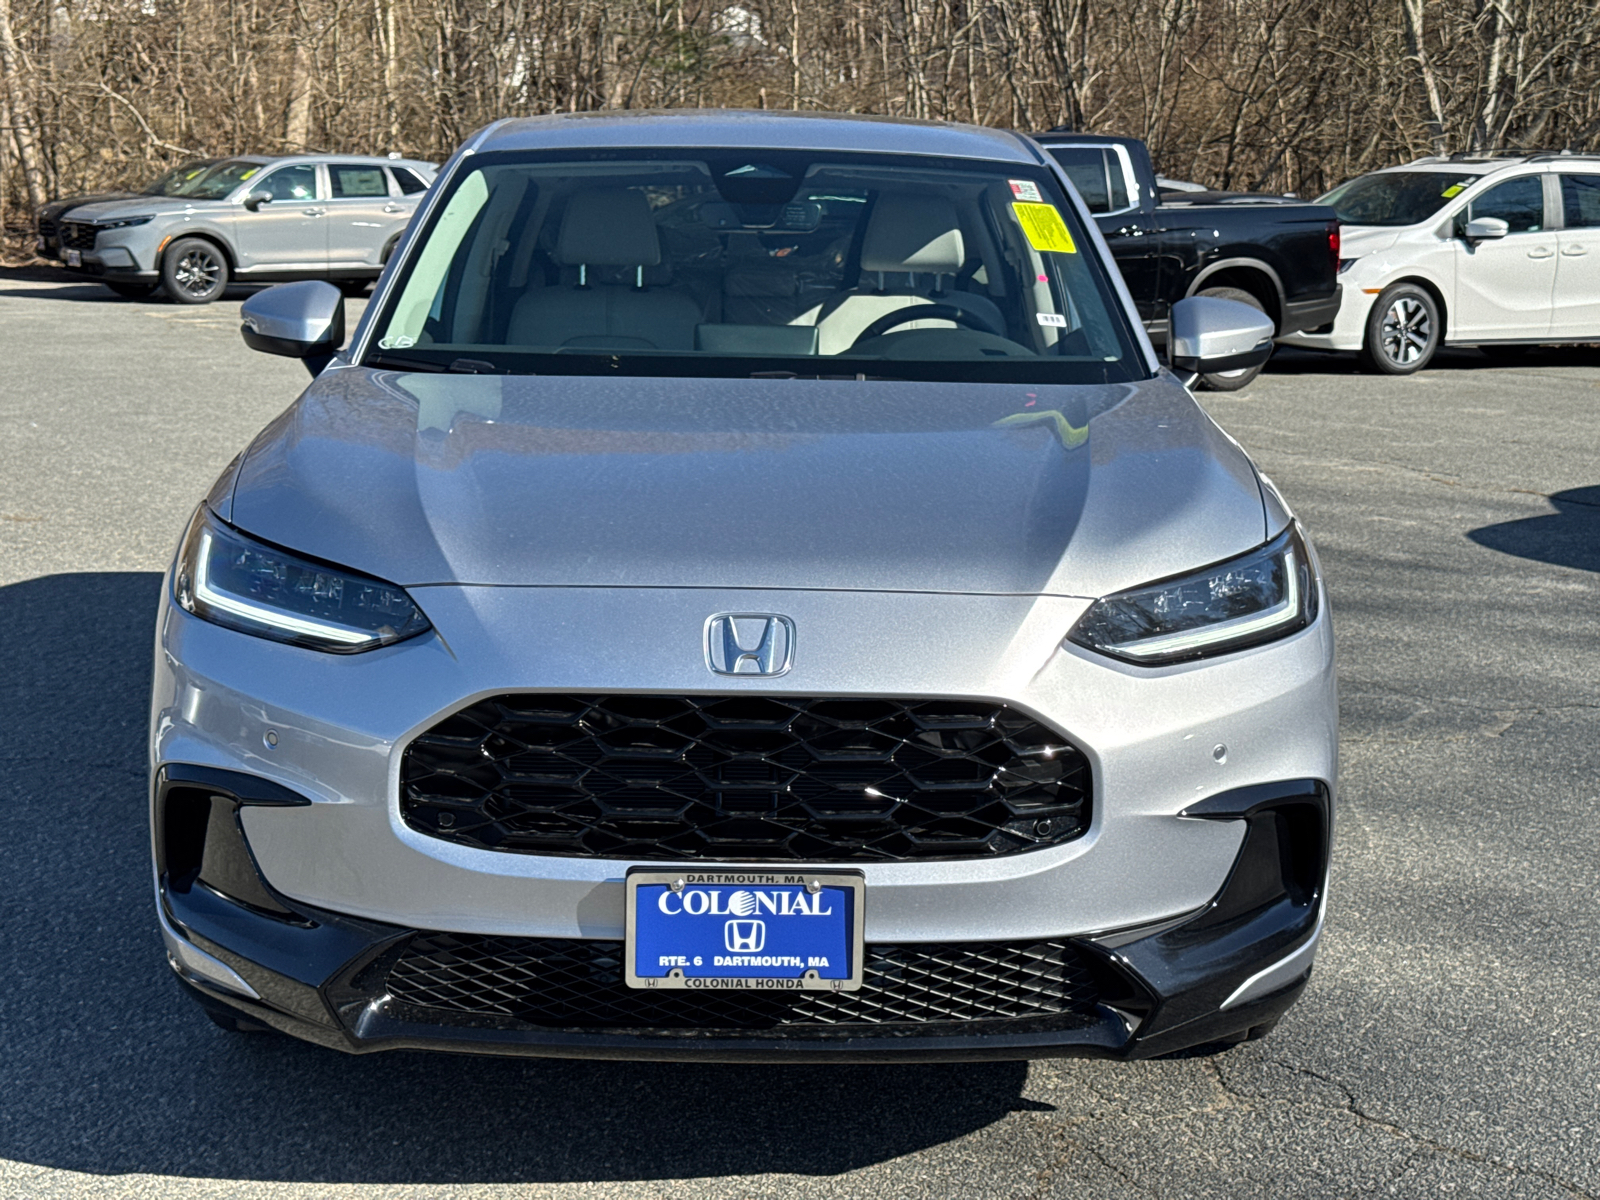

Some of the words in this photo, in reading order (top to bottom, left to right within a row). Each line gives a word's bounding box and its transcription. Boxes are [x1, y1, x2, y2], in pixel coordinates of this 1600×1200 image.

[784, 875, 805, 884] MA
[658, 890, 832, 917] COLONIAL
[659, 956, 690, 967] RTE.
[693, 956, 703, 967] 6
[713, 956, 804, 968] DARTMOUTH,
[808, 956, 829, 967] MA
[684, 978, 751, 989] COLONIAL
[756, 978, 804, 989] HONDA
